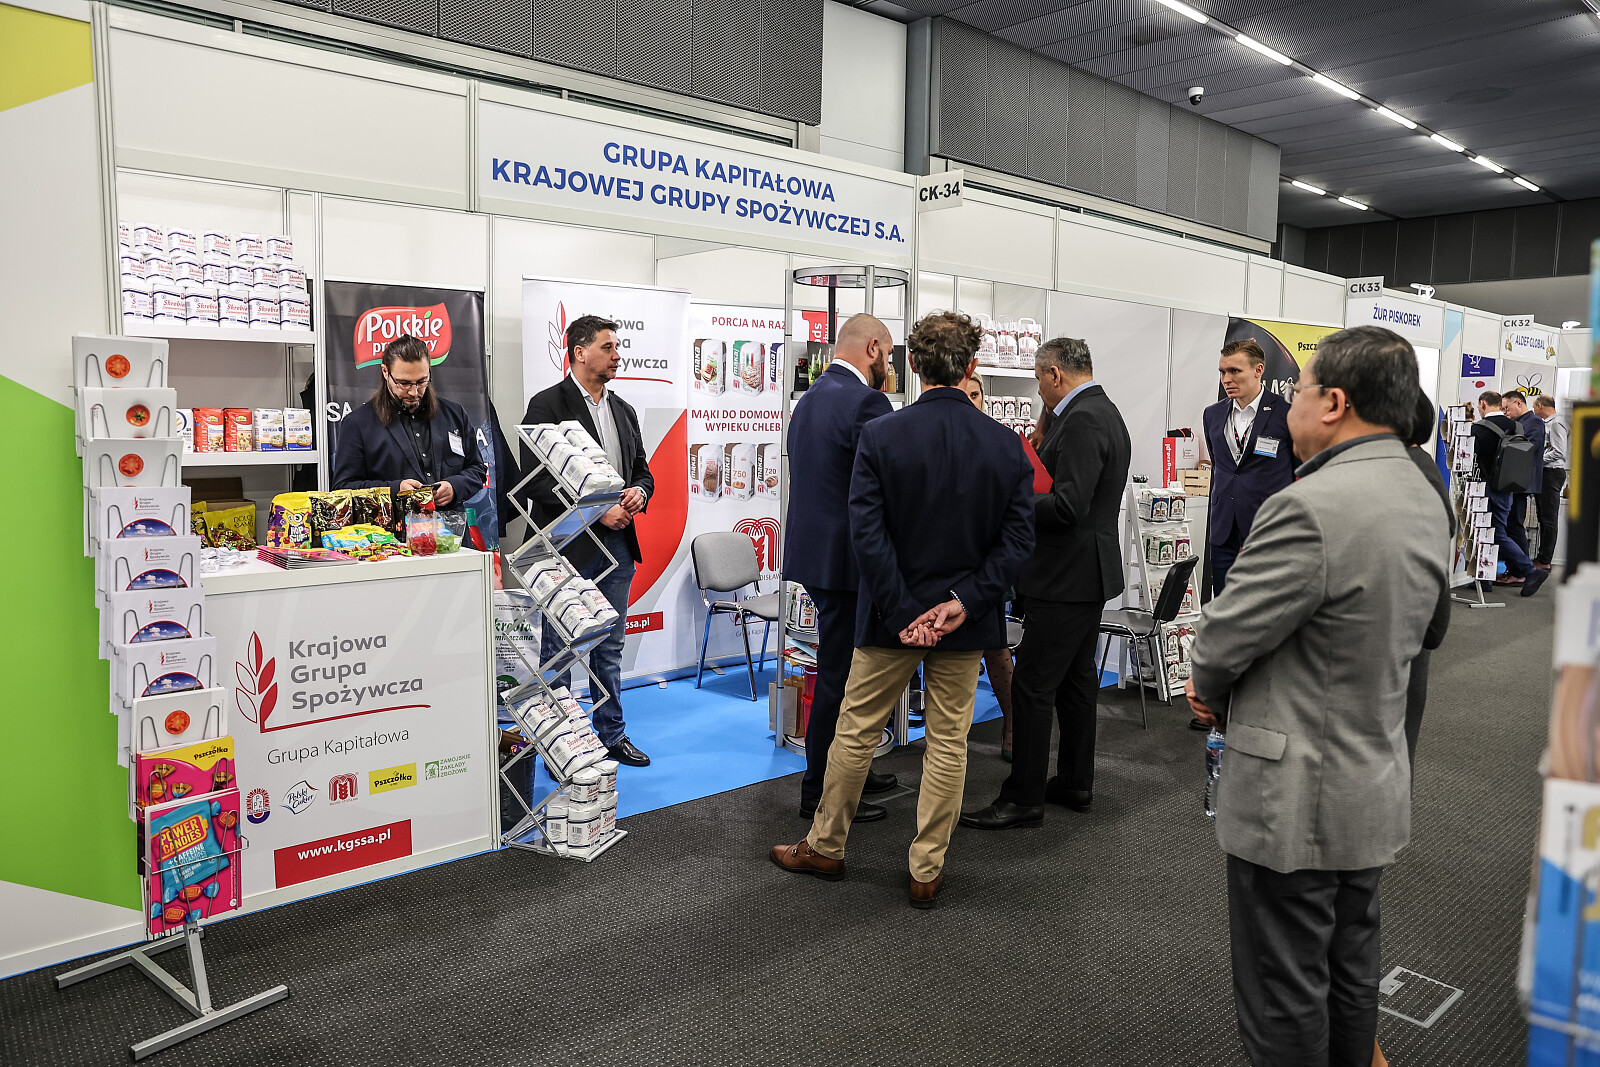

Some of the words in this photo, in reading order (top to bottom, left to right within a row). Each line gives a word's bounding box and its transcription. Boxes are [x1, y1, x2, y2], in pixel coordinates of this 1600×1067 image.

[603, 142, 688, 177] GRUPA
[695, 158, 835, 202] KAPITAŁOWA
[491, 158, 645, 201] KRAJOWEJ
[650, 183, 728, 215] GRUPY
[736, 200, 870, 237] SPOŻYWCZEJ
[874, 221, 905, 243] S.A.
[919, 181, 961, 202] CK-34
[1350, 282, 1380, 293] CK33
[712, 317, 749, 328] PORCJA
[751, 319, 765, 329] NA
[1373, 303, 1387, 322] ŻUR
[1389, 312, 1421, 327] PISKOREK
[1503, 319, 1530, 328] CK32
[366, 311, 443, 342] Polskie
[1530, 338, 1545, 350] GLOBAL
[618, 358, 668, 372] ywcza
[691, 410, 719, 422] MĄKI
[722, 410, 737, 419] DO
[705, 422, 750, 432] WYPIEKU
[752, 422, 783, 432] CHLEB
[733, 470, 747, 478] 750
[289, 635, 387, 660] Krajowa
[290, 661, 367, 684] Grupa
[292, 677, 423, 713] Spożywcza
[267, 744, 319, 765] Grupa
[324, 729, 409, 755] Kapitałowa
[440, 754, 471, 764] ZAMOJSKIE
[440, 761, 466, 771] ZAKŁADY
[161, 819, 199, 845] POWER
[162, 828, 202, 854] CANDIES
[297, 829, 392, 861] www.kgssa.pl
